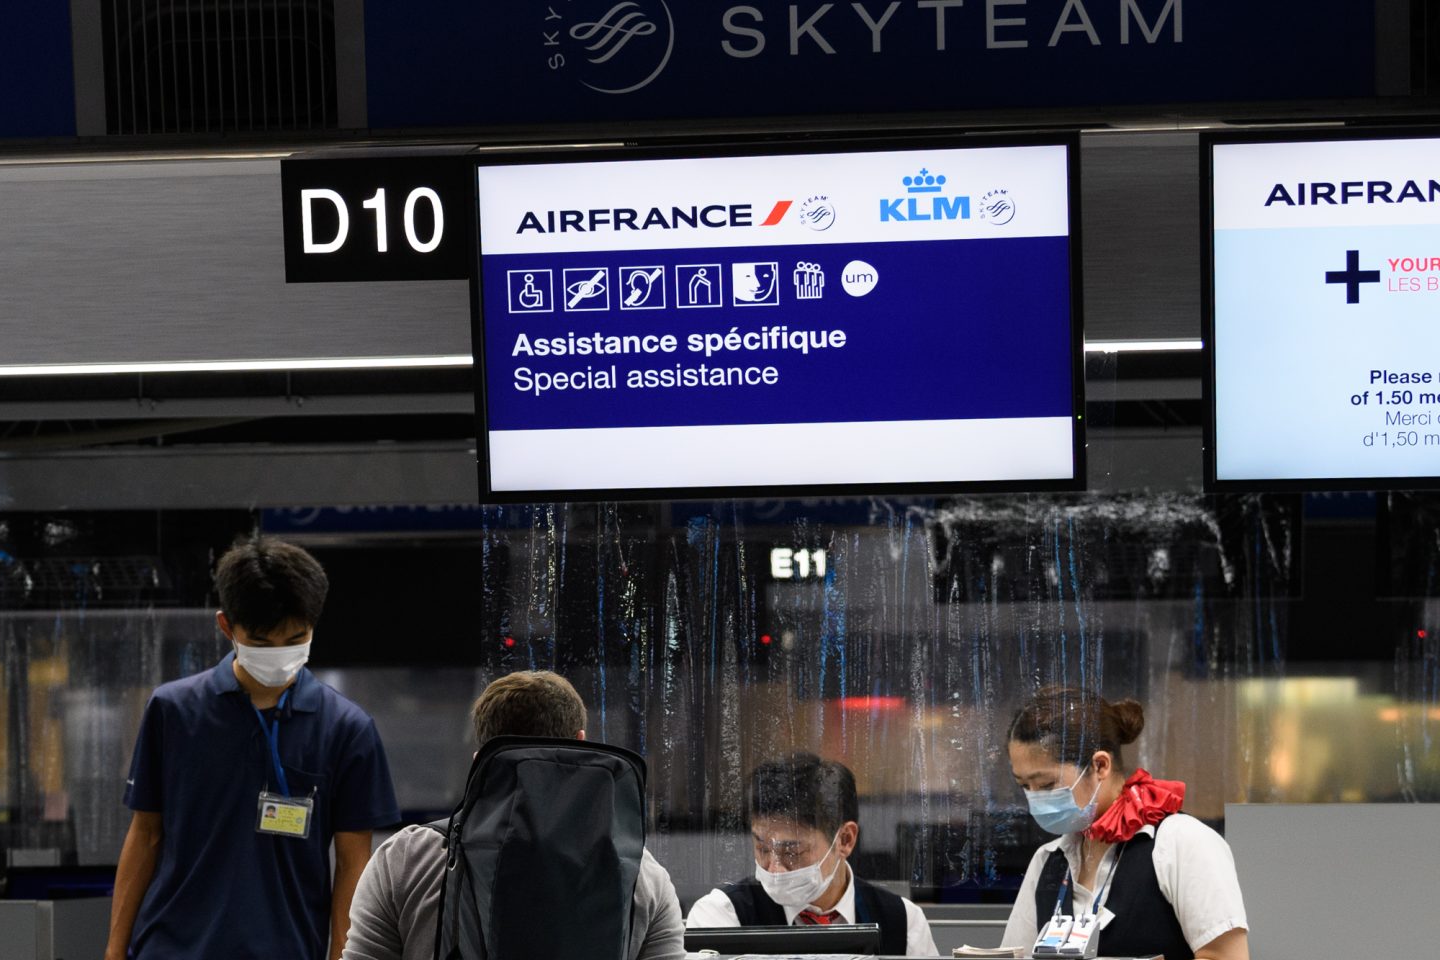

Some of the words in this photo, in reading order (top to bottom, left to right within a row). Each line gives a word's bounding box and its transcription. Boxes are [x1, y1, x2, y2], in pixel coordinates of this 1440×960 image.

[543, 0, 568, 70] SKY
[720, 0, 1184, 58] SKYTEAM
[301, 186, 444, 253] D10
[516, 203, 752, 234] AIRFRANCE
[879, 196, 971, 222] KLM
[1388, 257, 1440, 273] YOUR
[845, 273, 874, 284] um
[1388, 277, 1422, 292] LES
[512, 331, 678, 357] Assistance
[687, 326, 848, 357] spécifique
[513, 365, 617, 397] Special
[626, 363, 779, 389] assistance
[1369, 369, 1433, 384] Please
[1350, 391, 1369, 406] of
[1375, 390, 1413, 405] 1.50
[1385, 411, 1432, 426] Merci
[1363, 431, 1418, 448] d'1,50
[770, 547, 827, 579] E11
